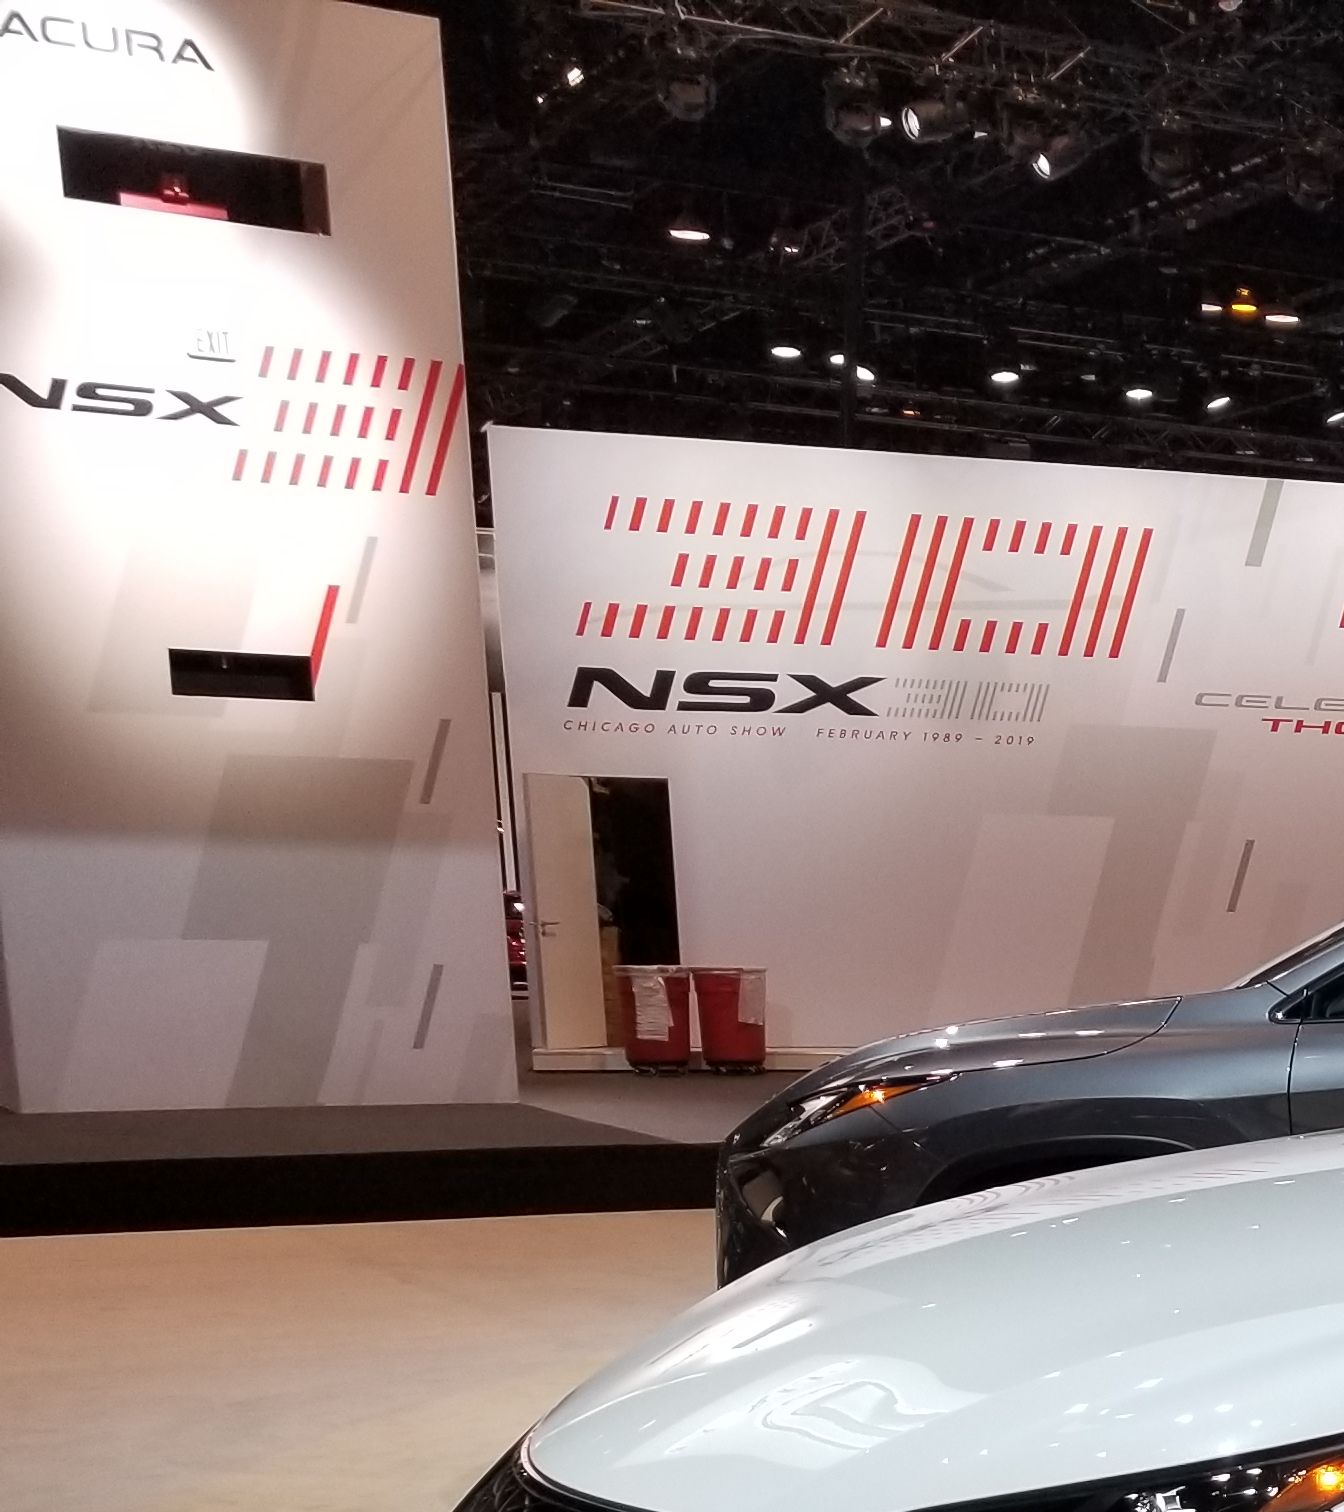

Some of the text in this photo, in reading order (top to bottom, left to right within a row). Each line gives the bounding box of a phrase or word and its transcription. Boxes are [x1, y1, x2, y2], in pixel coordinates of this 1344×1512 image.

[0, 10, 214, 72] ACURA
[196, 328, 230, 355] EXIT
[0, 372, 244, 427] NSX
[567, 666, 888, 717] NSX
[563, 719, 656, 735] CHICAGO
[667, 724, 718, 736] AUTO
[730, 725, 787, 737] SHOW
[816, 727, 913, 741] FEBRUARY
[922, 732, 964, 744] 1989
[994, 734, 1036, 746] 2019
